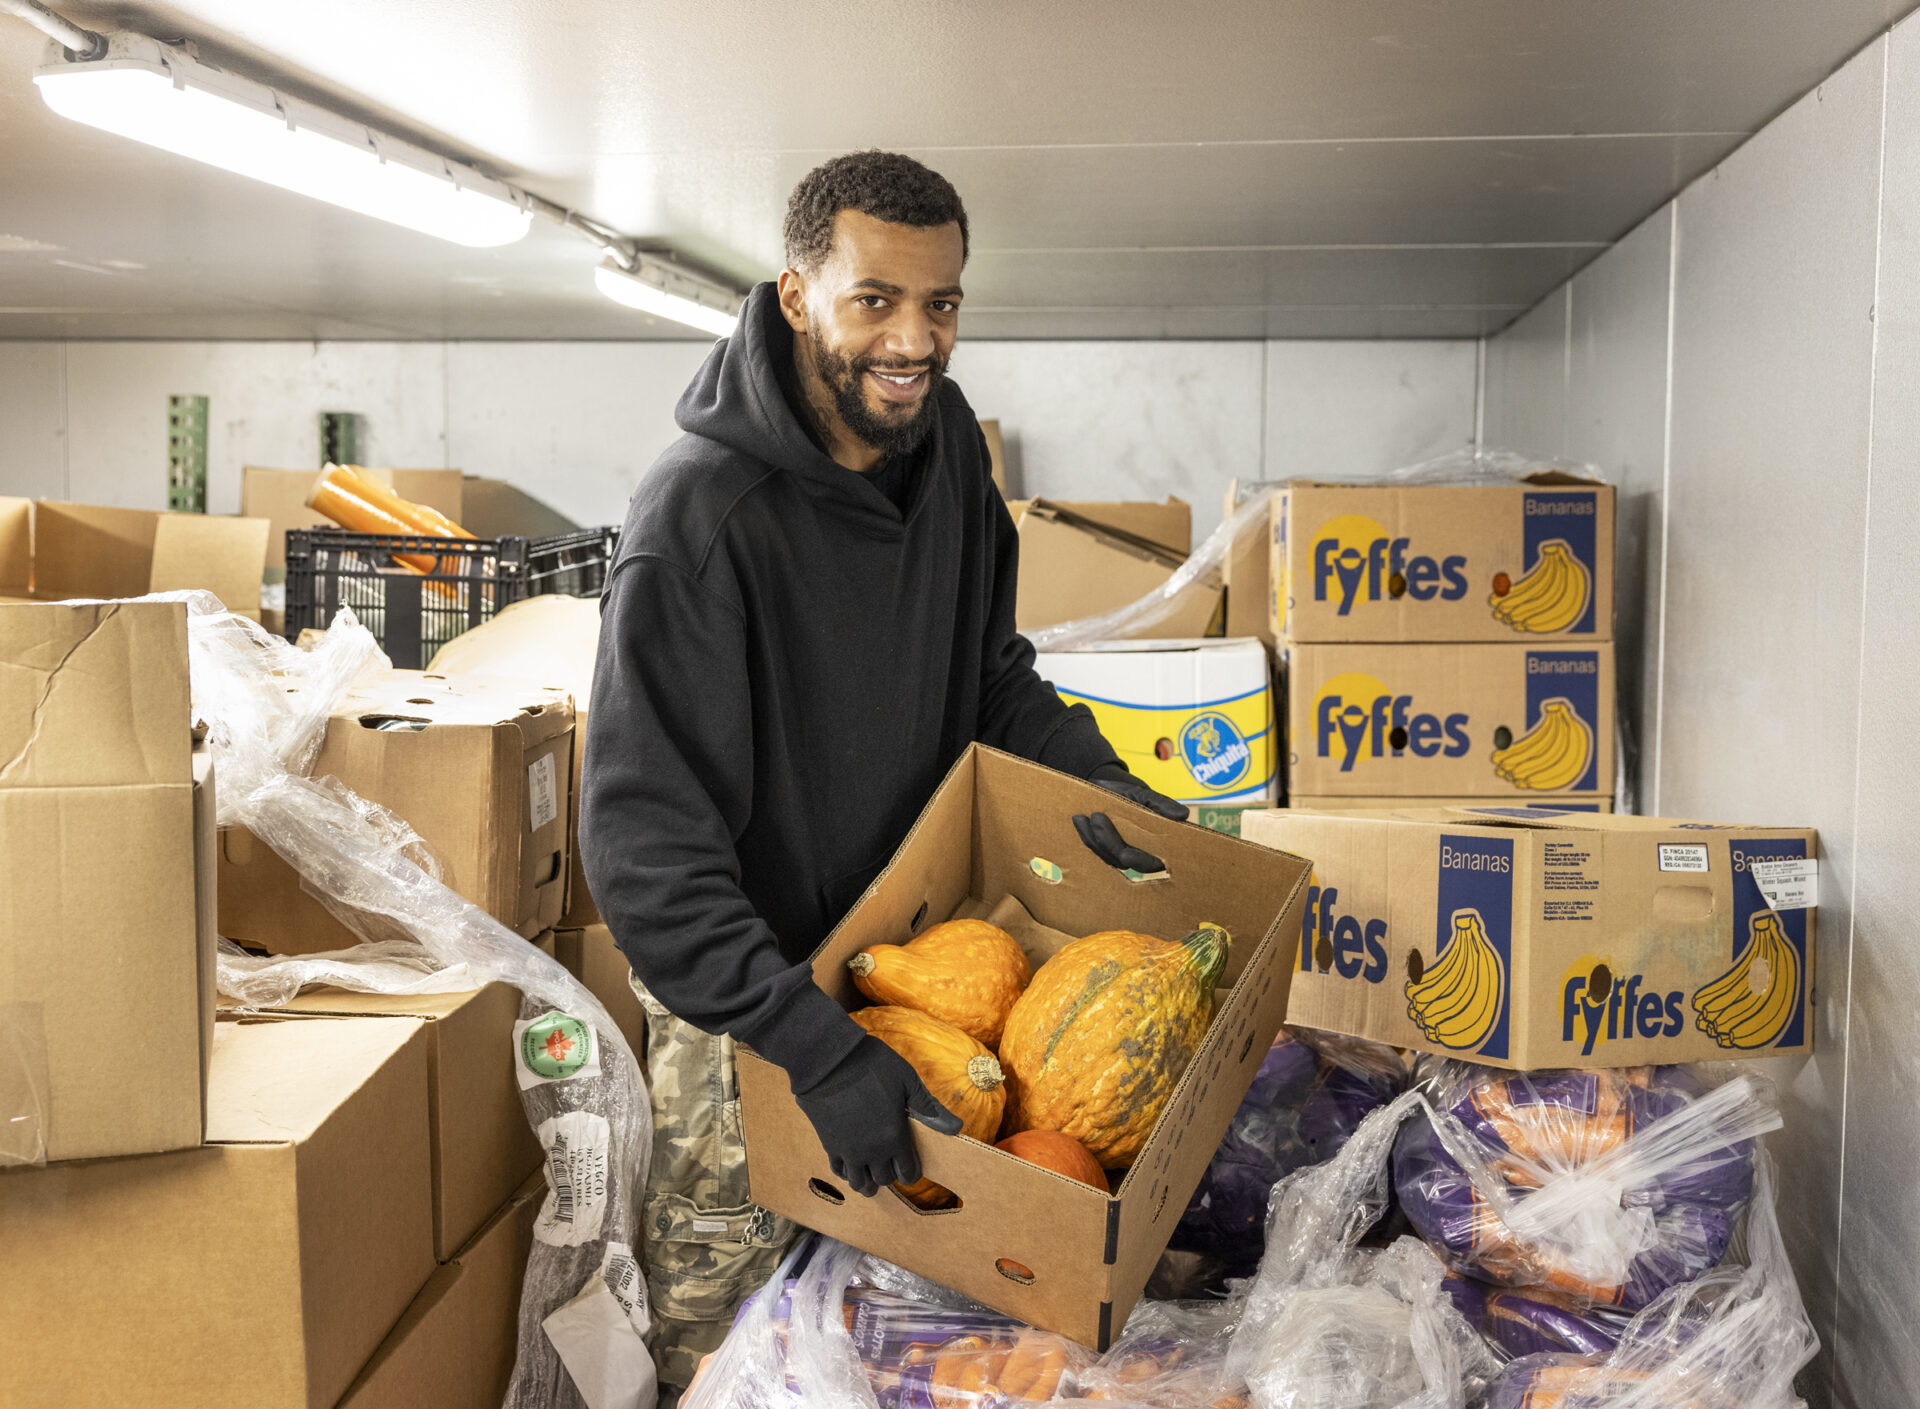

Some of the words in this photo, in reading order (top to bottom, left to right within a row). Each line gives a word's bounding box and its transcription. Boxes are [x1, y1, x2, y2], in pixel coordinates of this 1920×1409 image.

[1525, 499, 1595, 516] Bananas
[1527, 658, 1596, 675] Bananas
[1192, 738, 1249, 784] Chiquita
[1205, 811, 1240, 830] Orga
[1442, 846, 1510, 873] Bananas
[1301, 886, 1388, 984] ffes
[595, 1155, 604, 1196] VEGCO
